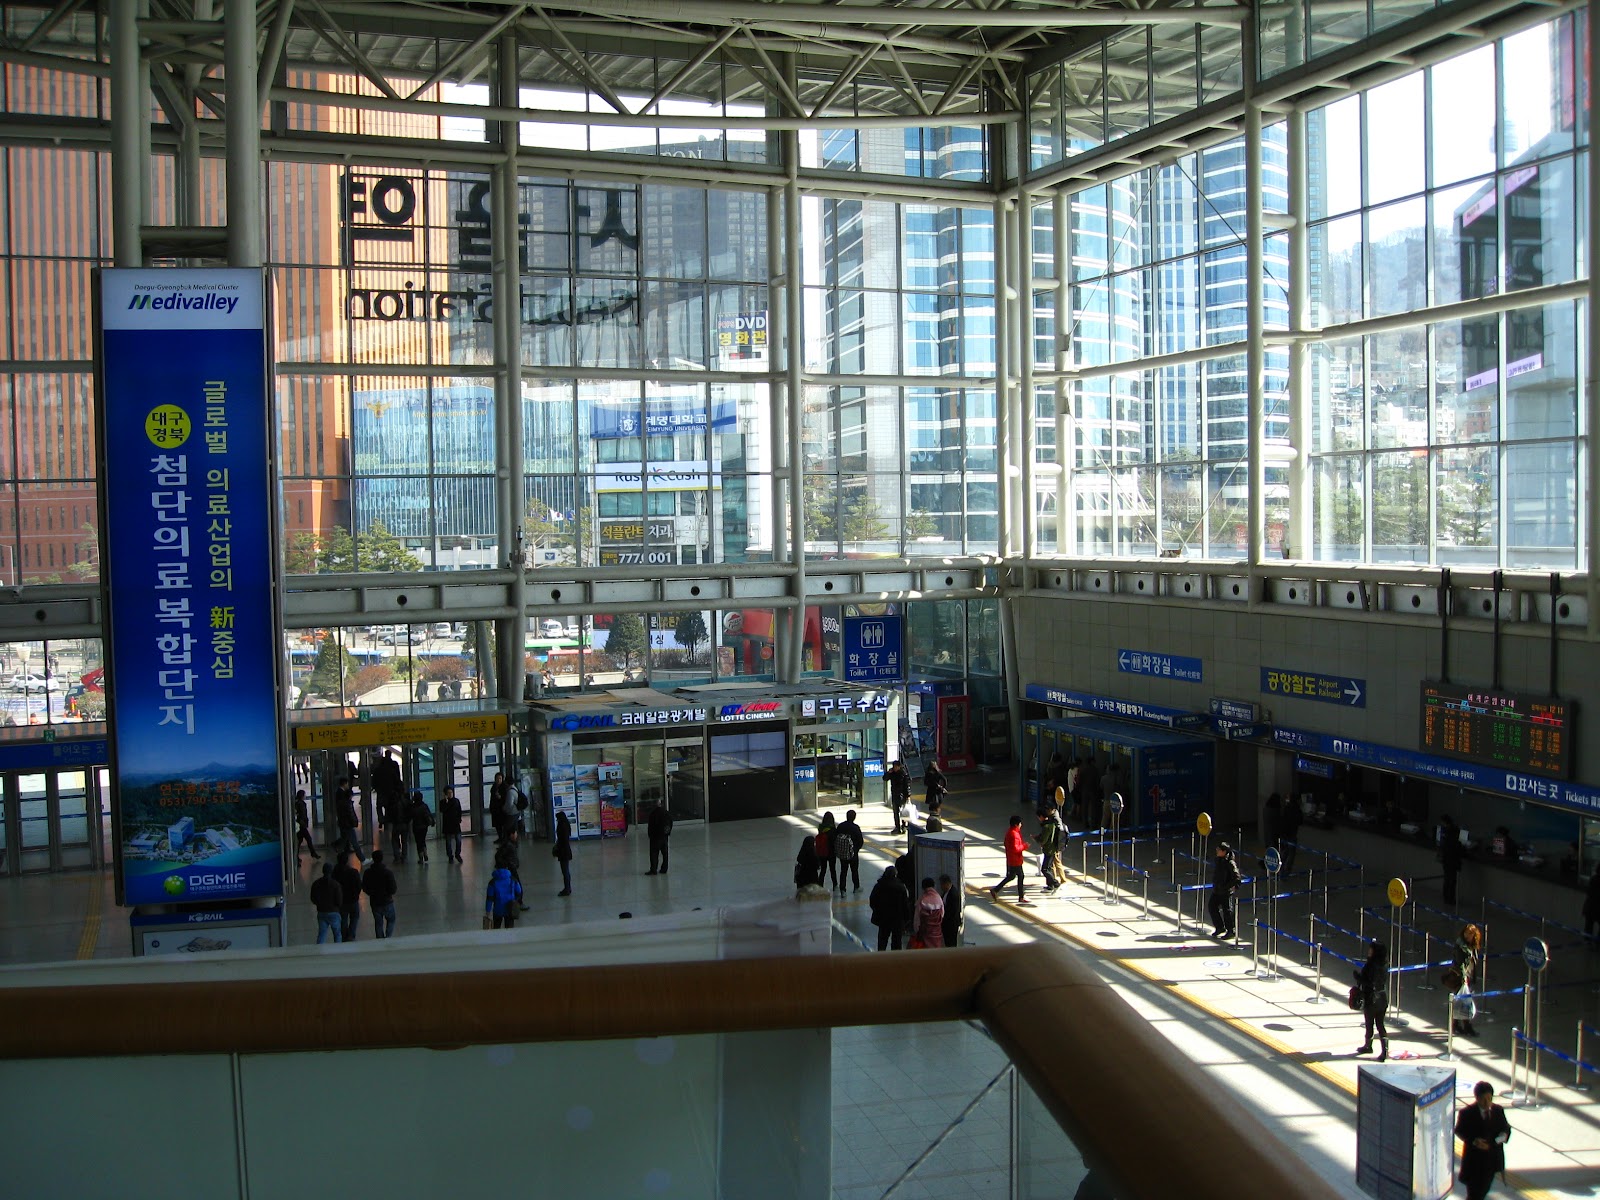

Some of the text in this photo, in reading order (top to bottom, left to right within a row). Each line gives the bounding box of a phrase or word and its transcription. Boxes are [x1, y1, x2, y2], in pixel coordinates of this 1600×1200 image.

[128, 293, 240, 314] Medivalley
[735, 317, 766, 329] DVD
[719, 330, 766, 346] 영화관
[152, 412, 184, 426] 대구
[645, 413, 707, 426] 계명대학교
[153, 428, 185, 442] 경북
[203, 380, 236, 679] 글로벌 의료산업의 新중심
[648, 524, 667, 539] 치과
[149, 454, 198, 735] 첨단의료복합단지
[849, 651, 897, 667] 화장실
[1142, 655, 1171, 675] 화장실
[849, 669, 868, 677] Toilet
[1268, 671, 1317, 695] 공항철도
[1319, 679, 1338, 689] Airport
[1319, 688, 1341, 699] Railroad
[820, 695, 888, 715] 구두수선
[621, 708, 706, 726] 코레일관광개발
[721, 712, 776, 722] LOTTE CINEMA
[1518, 776, 1547, 797] 표사는
[1549, 783, 1559, 799] 곳
[1565, 790, 1589, 805] Tickets
[189, 872, 246, 887] DGMIF
[188, 912, 225, 922] KORAIL
